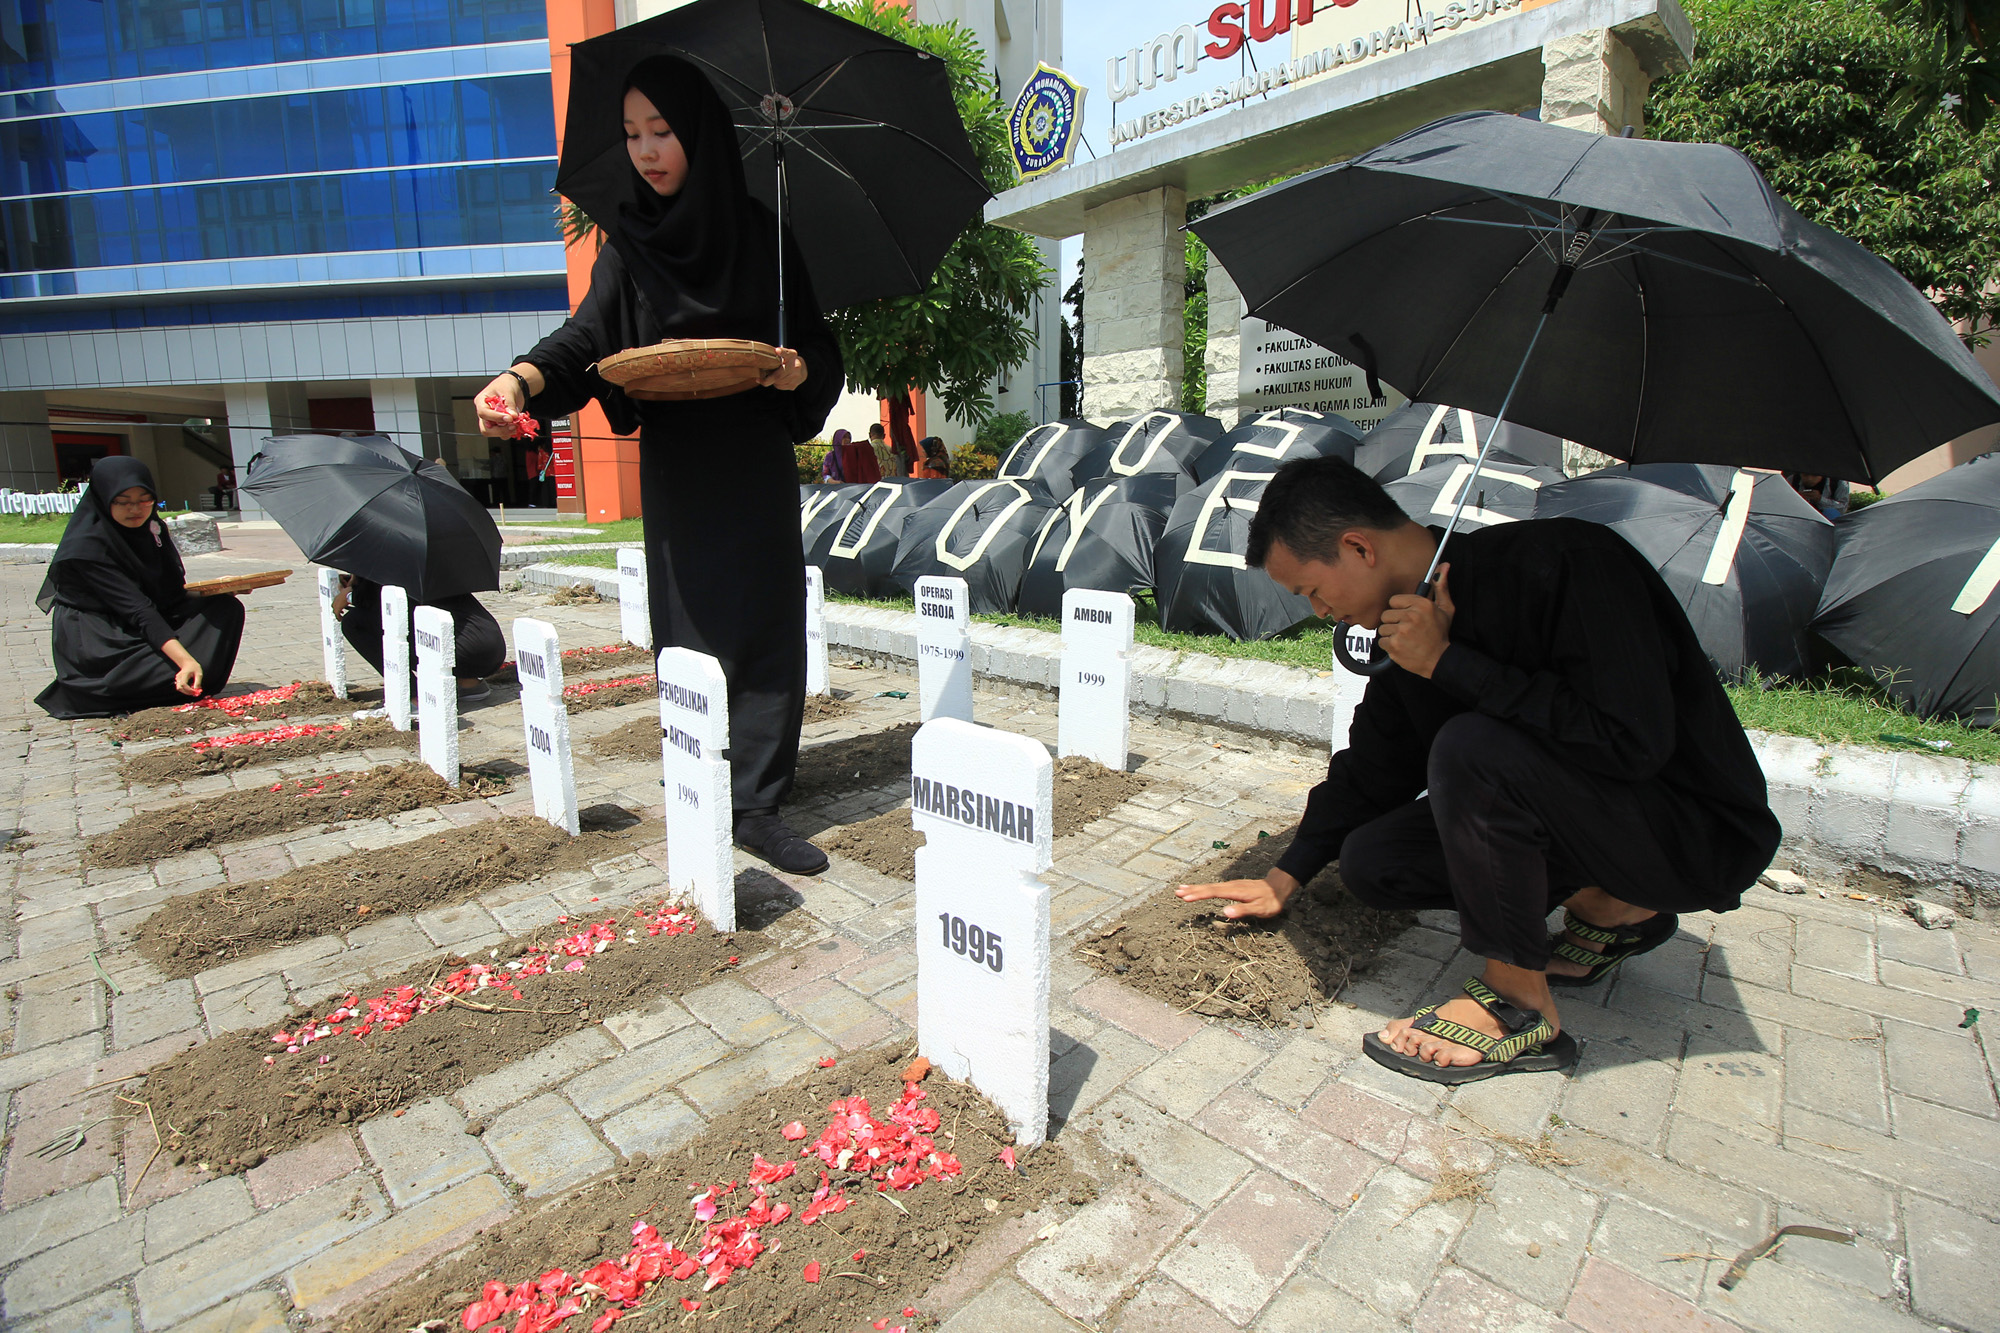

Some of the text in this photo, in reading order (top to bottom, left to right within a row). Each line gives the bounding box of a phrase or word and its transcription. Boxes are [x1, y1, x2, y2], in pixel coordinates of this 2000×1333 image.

[1107, 85, 1228, 145] UNIVERSITAS
[1229, 11, 1434, 103] MUHAMMADIYAH
[1013, 78, 1072, 144] UNIVERSITAS MUHAMMADIYAH
[1025, 146, 1060, 168] SURABAYA
[1265, 338, 1312, 354] FAKULTAS
[1264, 356, 1353, 375] FAKULTAS EKONO
[1263, 376, 1352, 396] FAKULTAS HUKUM
[1313, 399, 1350, 412] AGAMA
[1353, 395, 1387, 410] ISLAM
[921, 585, 953, 600] OPERASI
[921, 602, 955, 620] SEROJA
[1073, 607, 1112, 624] AMBON
[416, 628, 441, 653] TRISAKTI
[1346, 635, 1373, 653] TAN
[920, 644, 964, 661] 1975-1999
[518, 650, 546, 680] MUNIR
[1078, 671, 1105, 687] 1999
[659, 680, 708, 716] PENCULIKAN
[529, 724, 551, 756] 2004
[669, 725, 701, 760] AKTIVIS
[678, 783, 699, 810] 1998
[913, 776, 1034, 844] MARSINAH
[938, 912, 1004, 973] 1995
